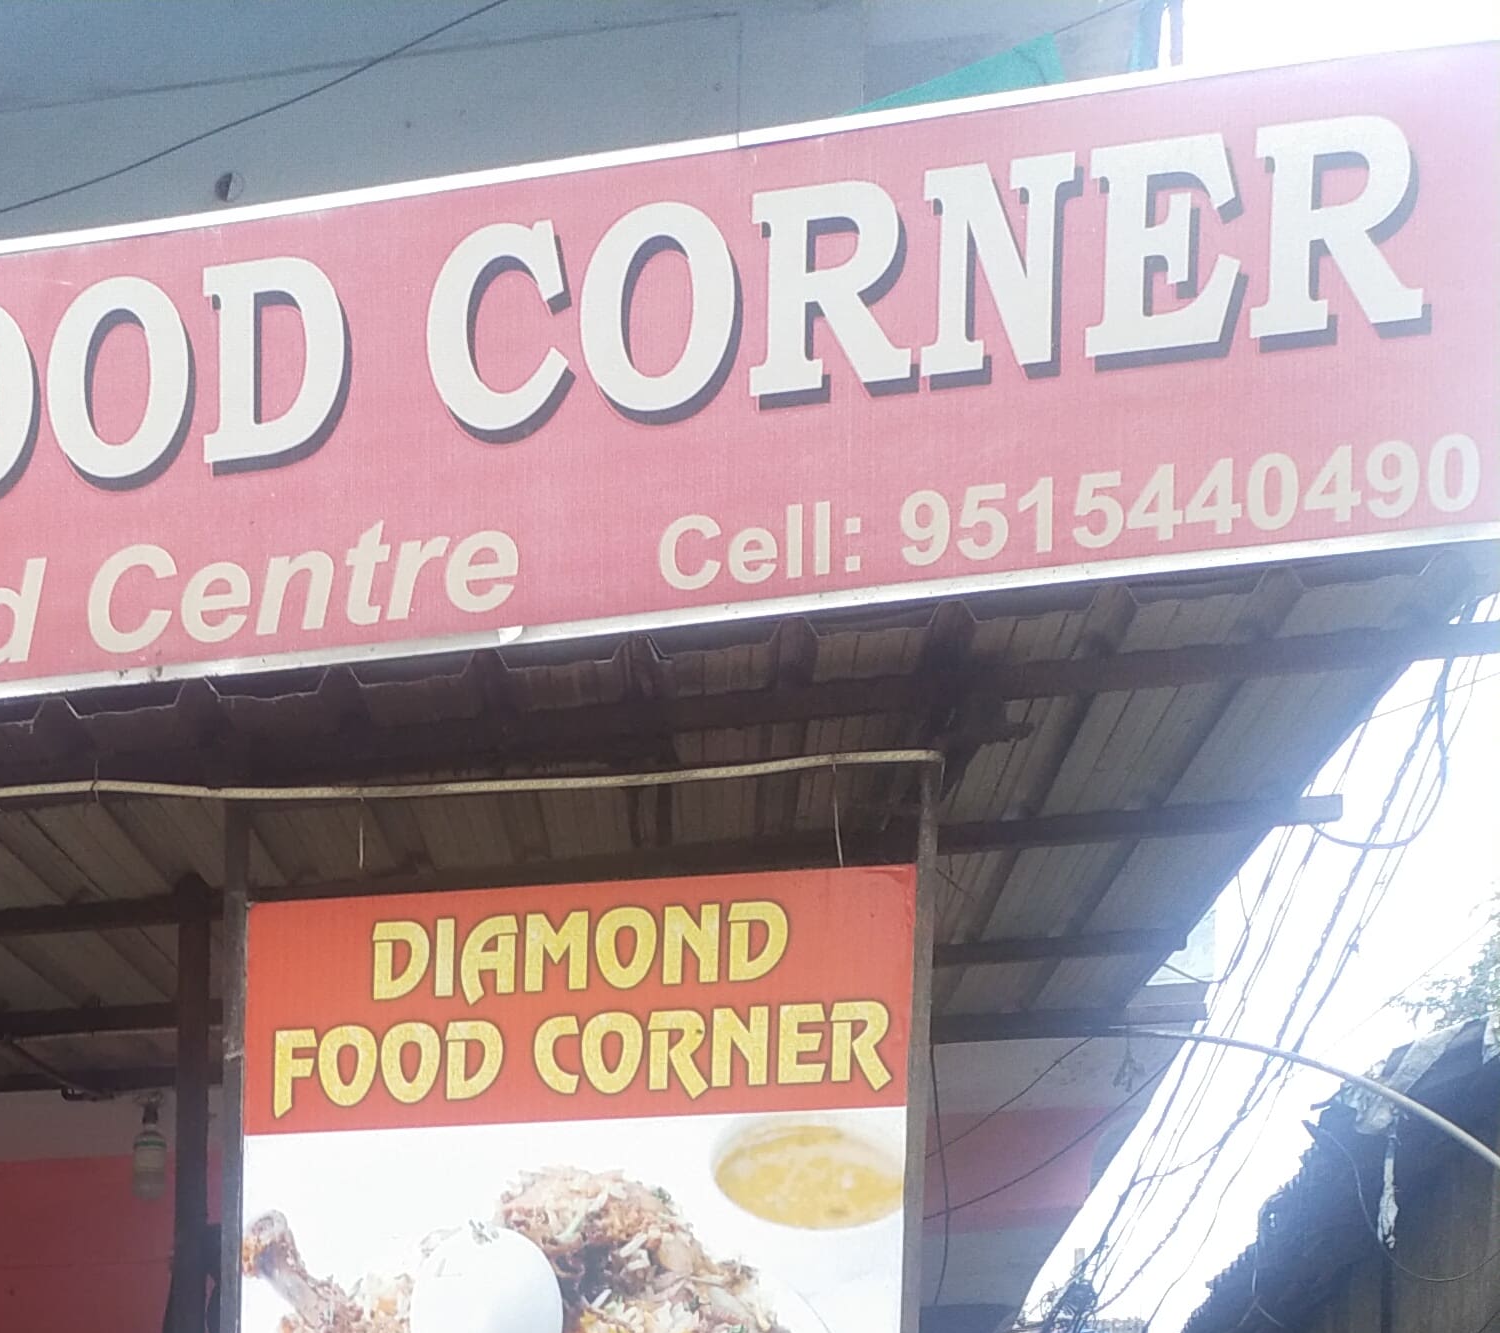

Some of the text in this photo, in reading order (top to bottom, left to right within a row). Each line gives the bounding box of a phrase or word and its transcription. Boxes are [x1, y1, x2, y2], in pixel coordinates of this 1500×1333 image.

[426, 115, 1428, 436] CORNER
[658, 433, 1482, 591] Cell: 9515440490
[87, 521, 519, 655] Centre
[372, 900, 789, 1006] DIAMOND
[273, 1000, 892, 1118] FOOD CORNER
